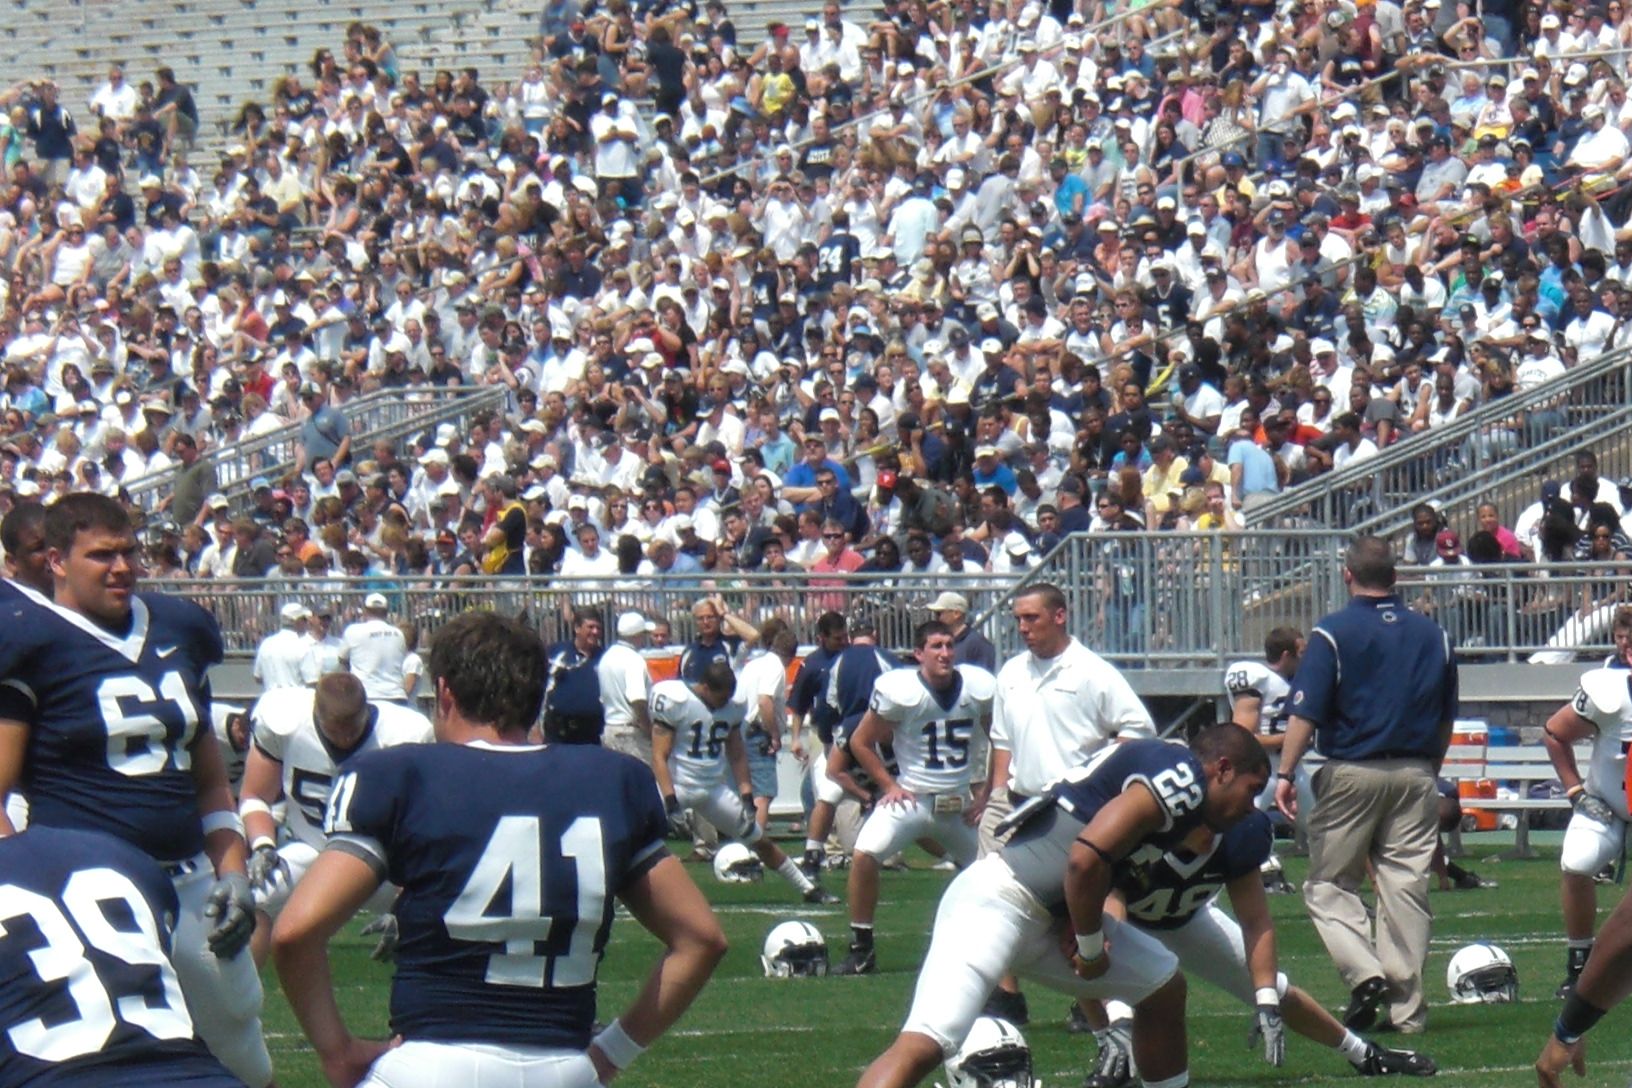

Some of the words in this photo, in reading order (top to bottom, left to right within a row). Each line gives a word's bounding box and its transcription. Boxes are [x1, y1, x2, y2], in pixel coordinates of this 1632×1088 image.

[1228, 670, 1249, 690] 28
[96, 669, 199, 777] 61
[686, 719, 730, 759] 16
[921, 718, 975, 770] 15
[1151, 761, 1204, 818] 22
[443, 815, 607, 989] 41
[0, 866, 195, 1063] 39
